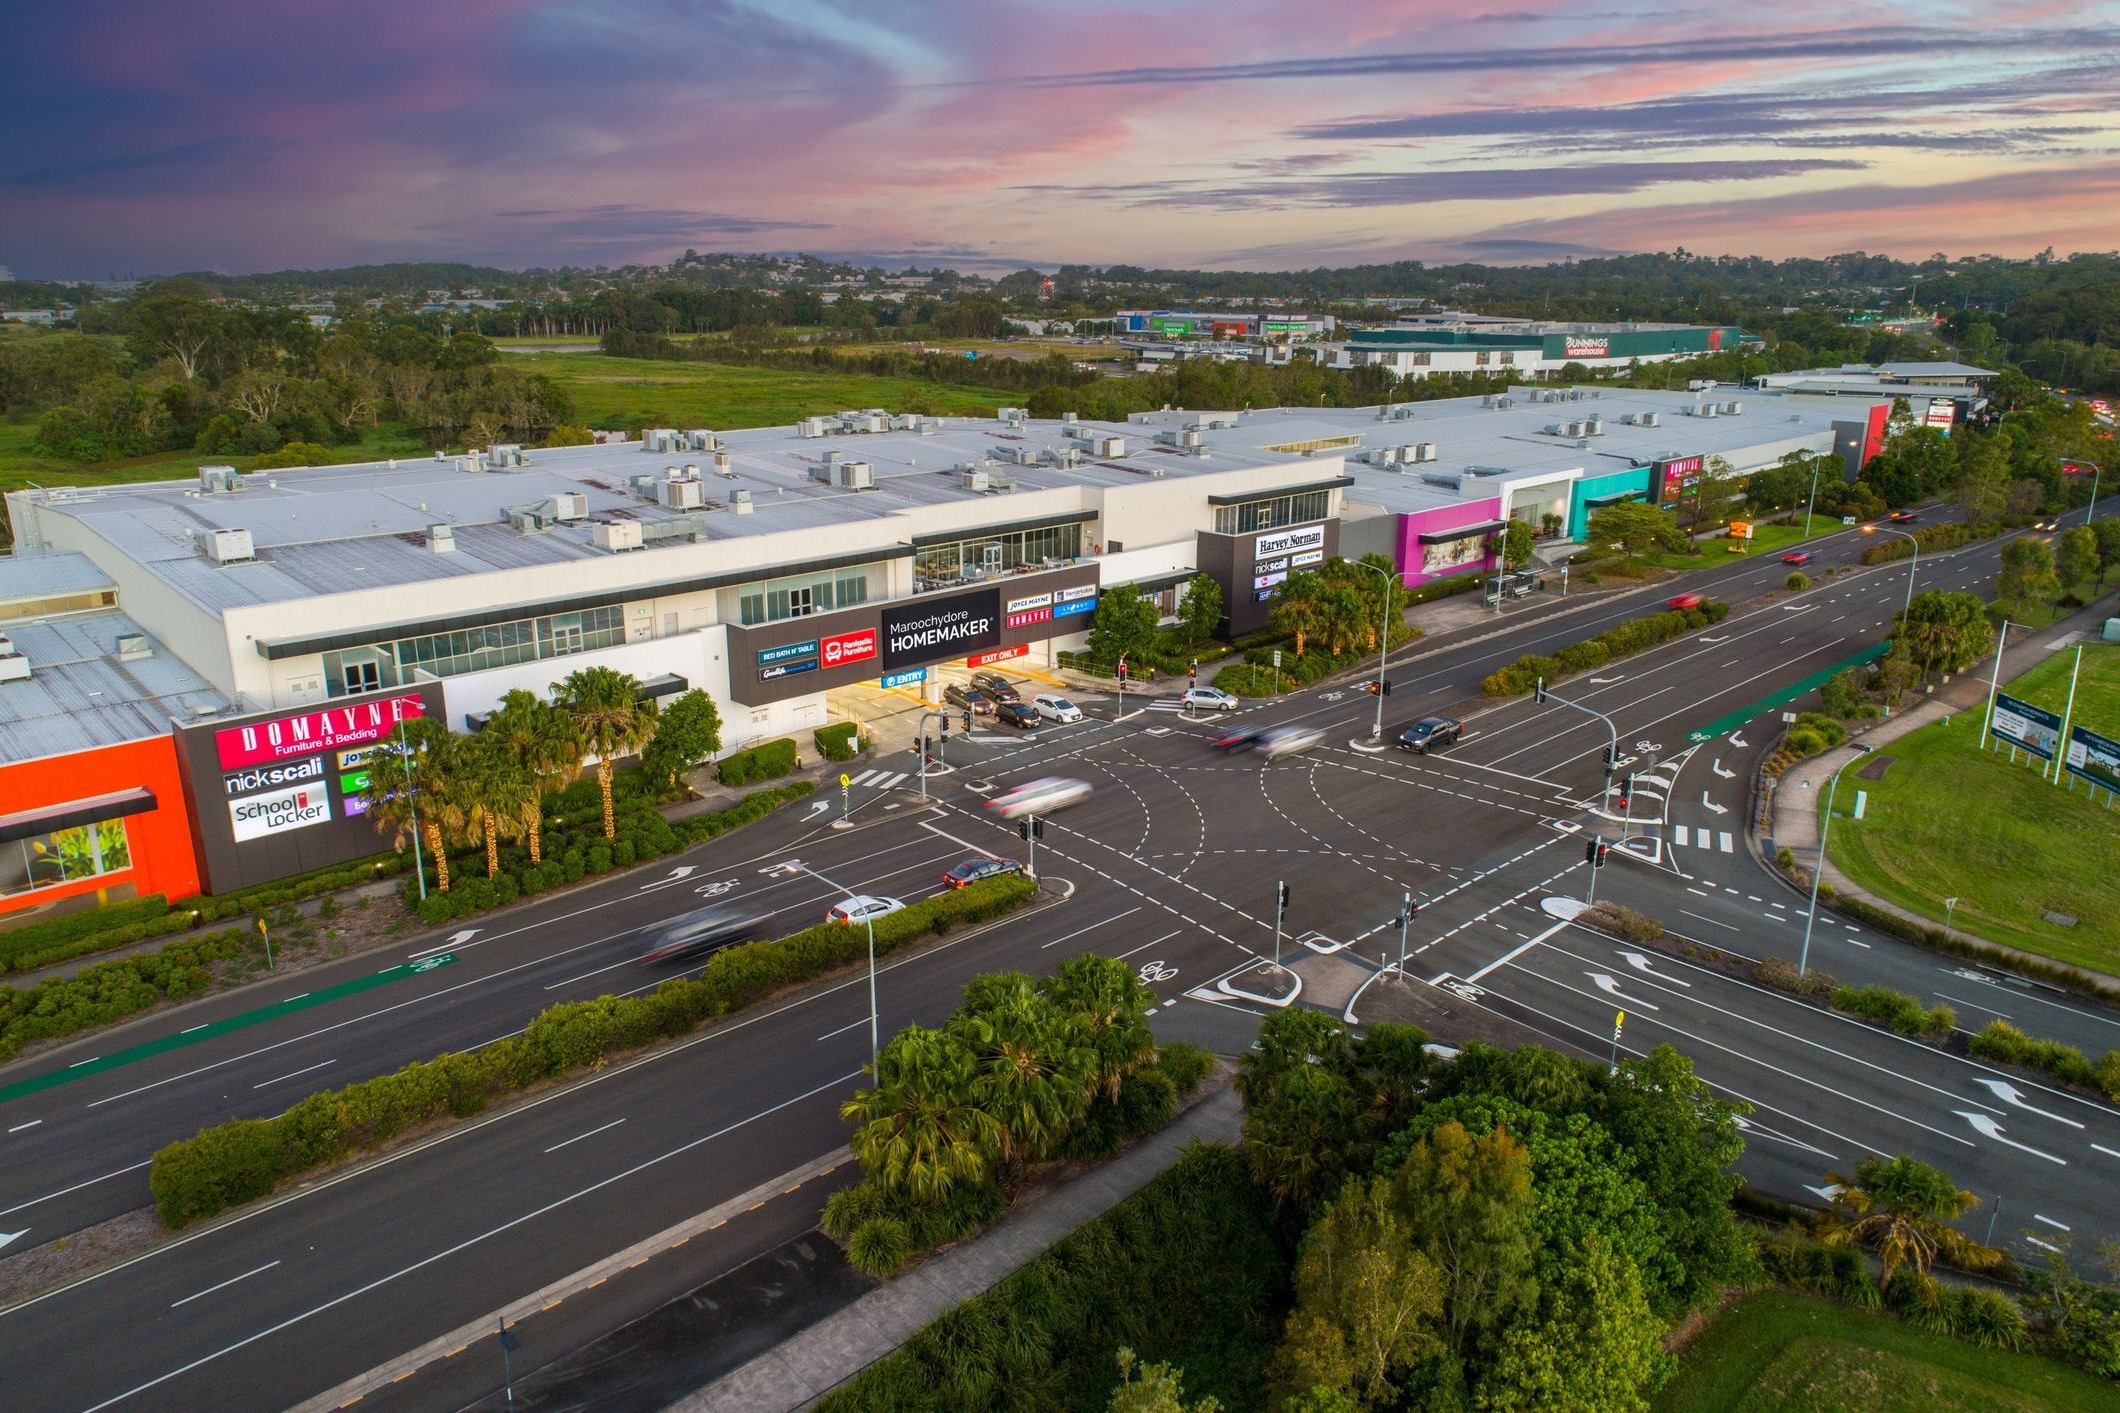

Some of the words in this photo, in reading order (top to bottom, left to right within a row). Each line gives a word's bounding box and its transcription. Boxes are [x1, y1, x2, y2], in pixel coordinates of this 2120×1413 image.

[1260, 537, 1289, 552] Harvey
[1290, 532, 1320, 546] Norman
[1028, 596, 1049, 605] MAYNE
[890, 610, 968, 635] Maroochydore
[843, 637, 873, 649] Fantastic
[891, 618, 989, 653] HOMEMAKER
[763, 652, 775, 660] BED
[776, 650, 791, 658] BATH
[798, 644, 815, 653] TABLE
[843, 645, 873, 657] Furniture
[981, 653, 998, 664] EXIT
[999, 649, 1018, 660] ONLY
[897, 671, 923, 684] ENTRY
[241, 698, 402, 752] DOMAYNE
[275, 738, 323, 756] Furniture
[325, 736, 334, 746] &
[335, 727, 377, 744] Bedding
[236, 794, 297, 821] School
[267, 804, 323, 828] Locker
